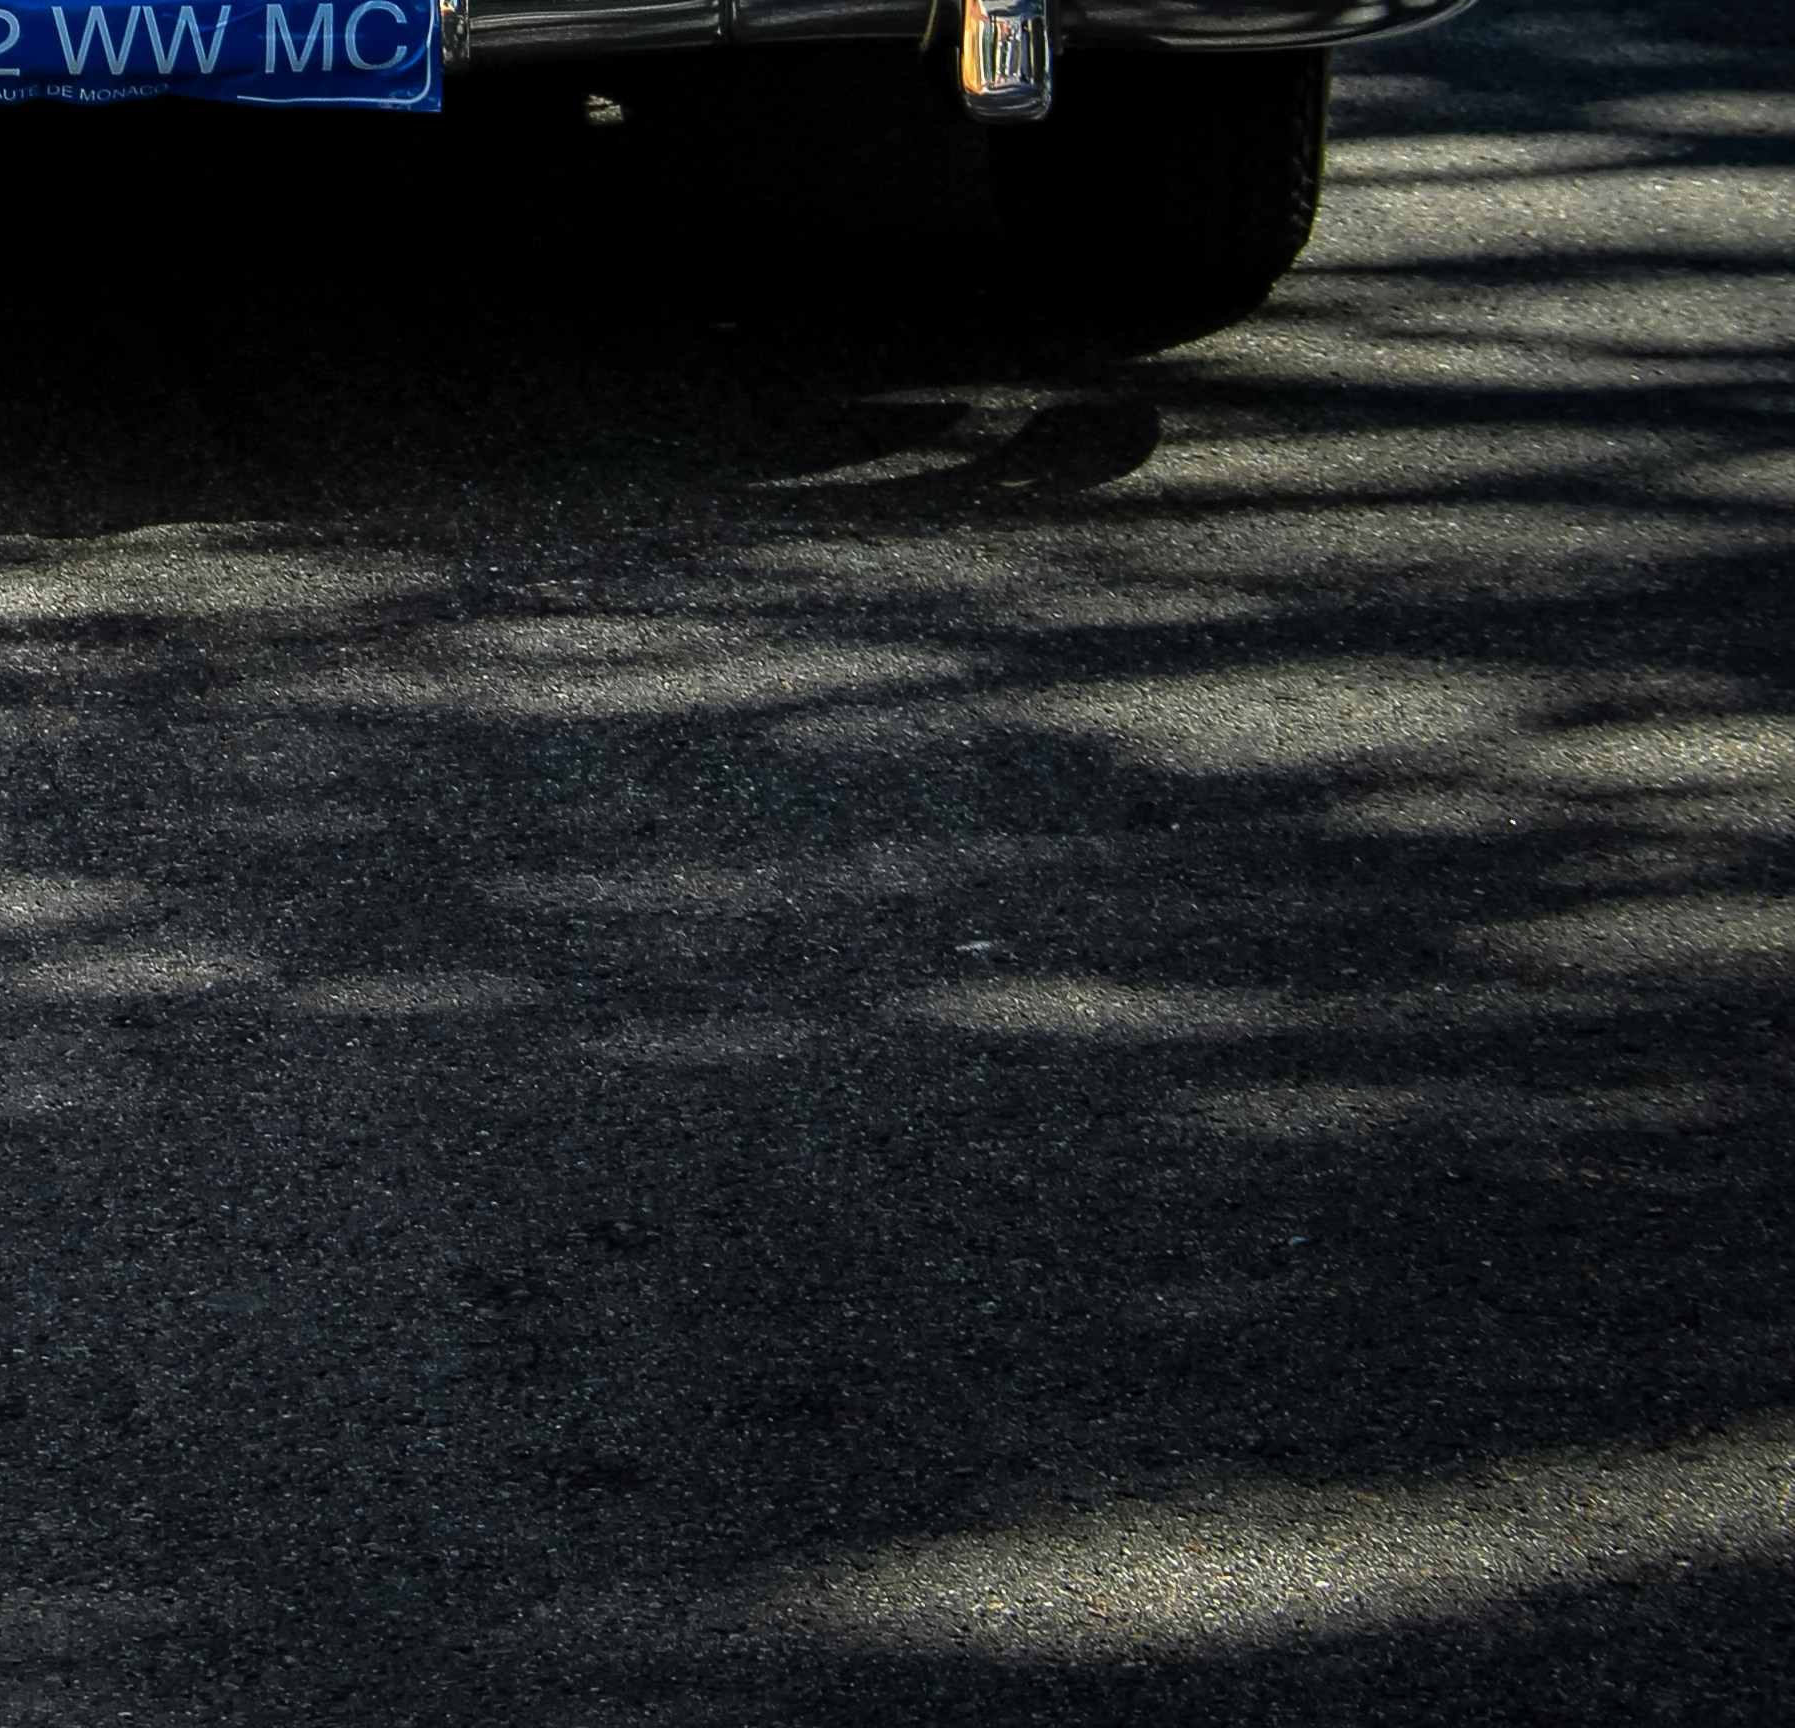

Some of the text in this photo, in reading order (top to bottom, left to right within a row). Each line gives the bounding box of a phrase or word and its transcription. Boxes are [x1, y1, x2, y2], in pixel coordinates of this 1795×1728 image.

[51, 5, 232, 76] WW
[264, 0, 408, 72] MC
[46, 84, 74, 98] DE
[78, 82, 169, 102] MONACO
